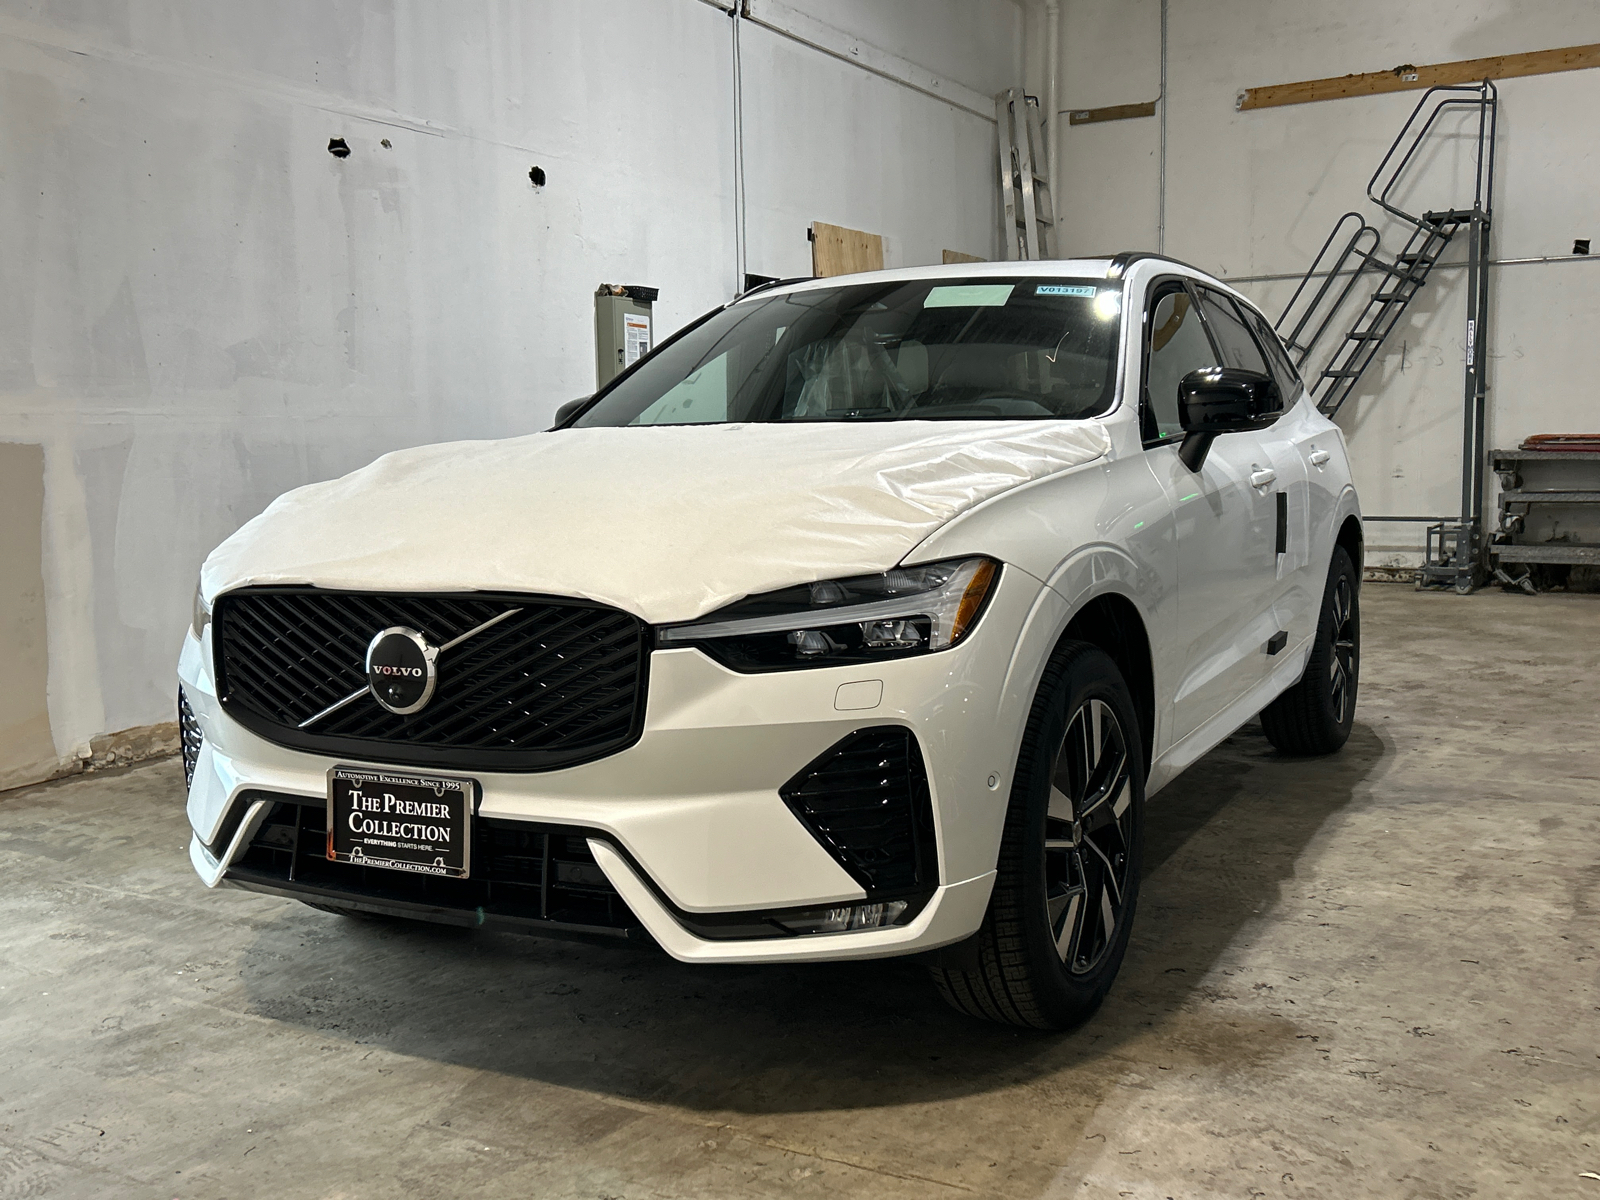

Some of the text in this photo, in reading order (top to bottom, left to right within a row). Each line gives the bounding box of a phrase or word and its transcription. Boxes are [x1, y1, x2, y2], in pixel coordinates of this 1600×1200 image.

[373, 665, 422, 677] VOLVO
[336, 771, 460, 790] AUTOMOTIVE EXCELLENCE SINCE 1995
[348, 789, 450, 819] THE PREMIER
[348, 811, 451, 843] COLLECTION
[363, 838, 397, 848] EVERYTHING
[397, 842, 418, 850] STARTS
